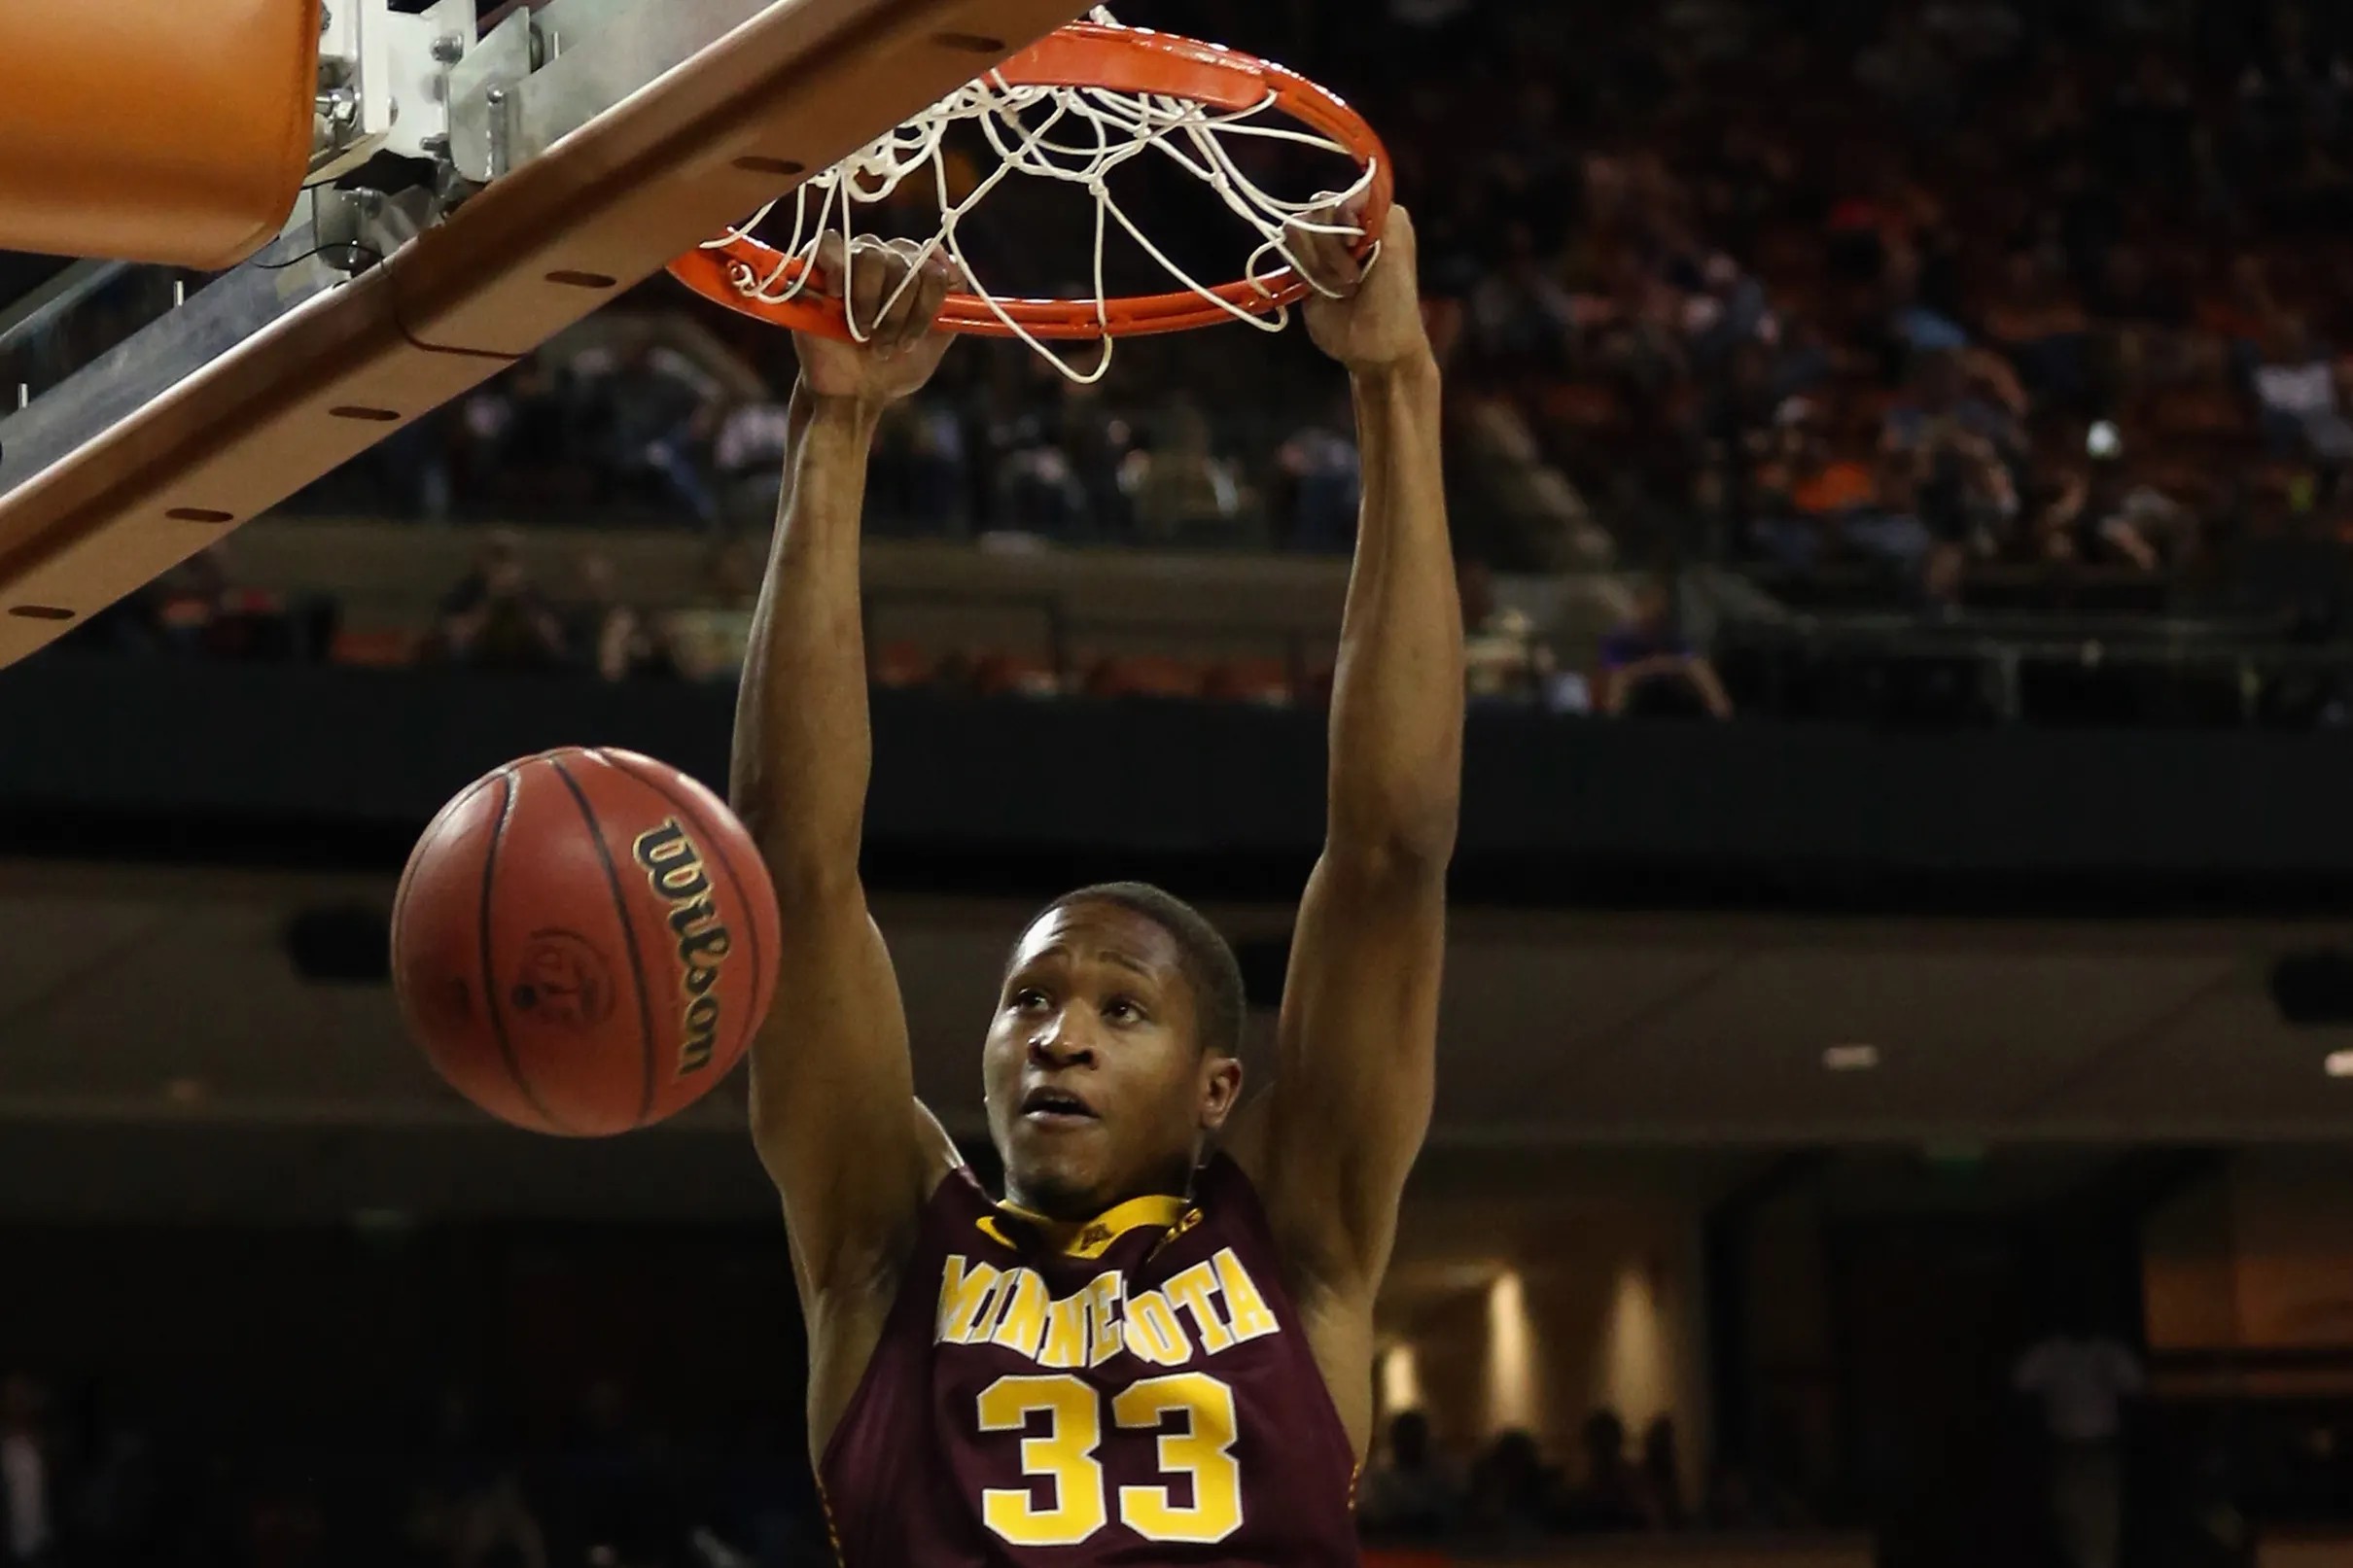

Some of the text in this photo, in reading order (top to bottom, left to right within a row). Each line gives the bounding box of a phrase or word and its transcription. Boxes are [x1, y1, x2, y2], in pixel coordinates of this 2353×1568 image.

[632, 816, 730, 1076] Wilson
[934, 1247, 1280, 1367] MINNEOTA
[976, 1372, 1244, 1546] 33
